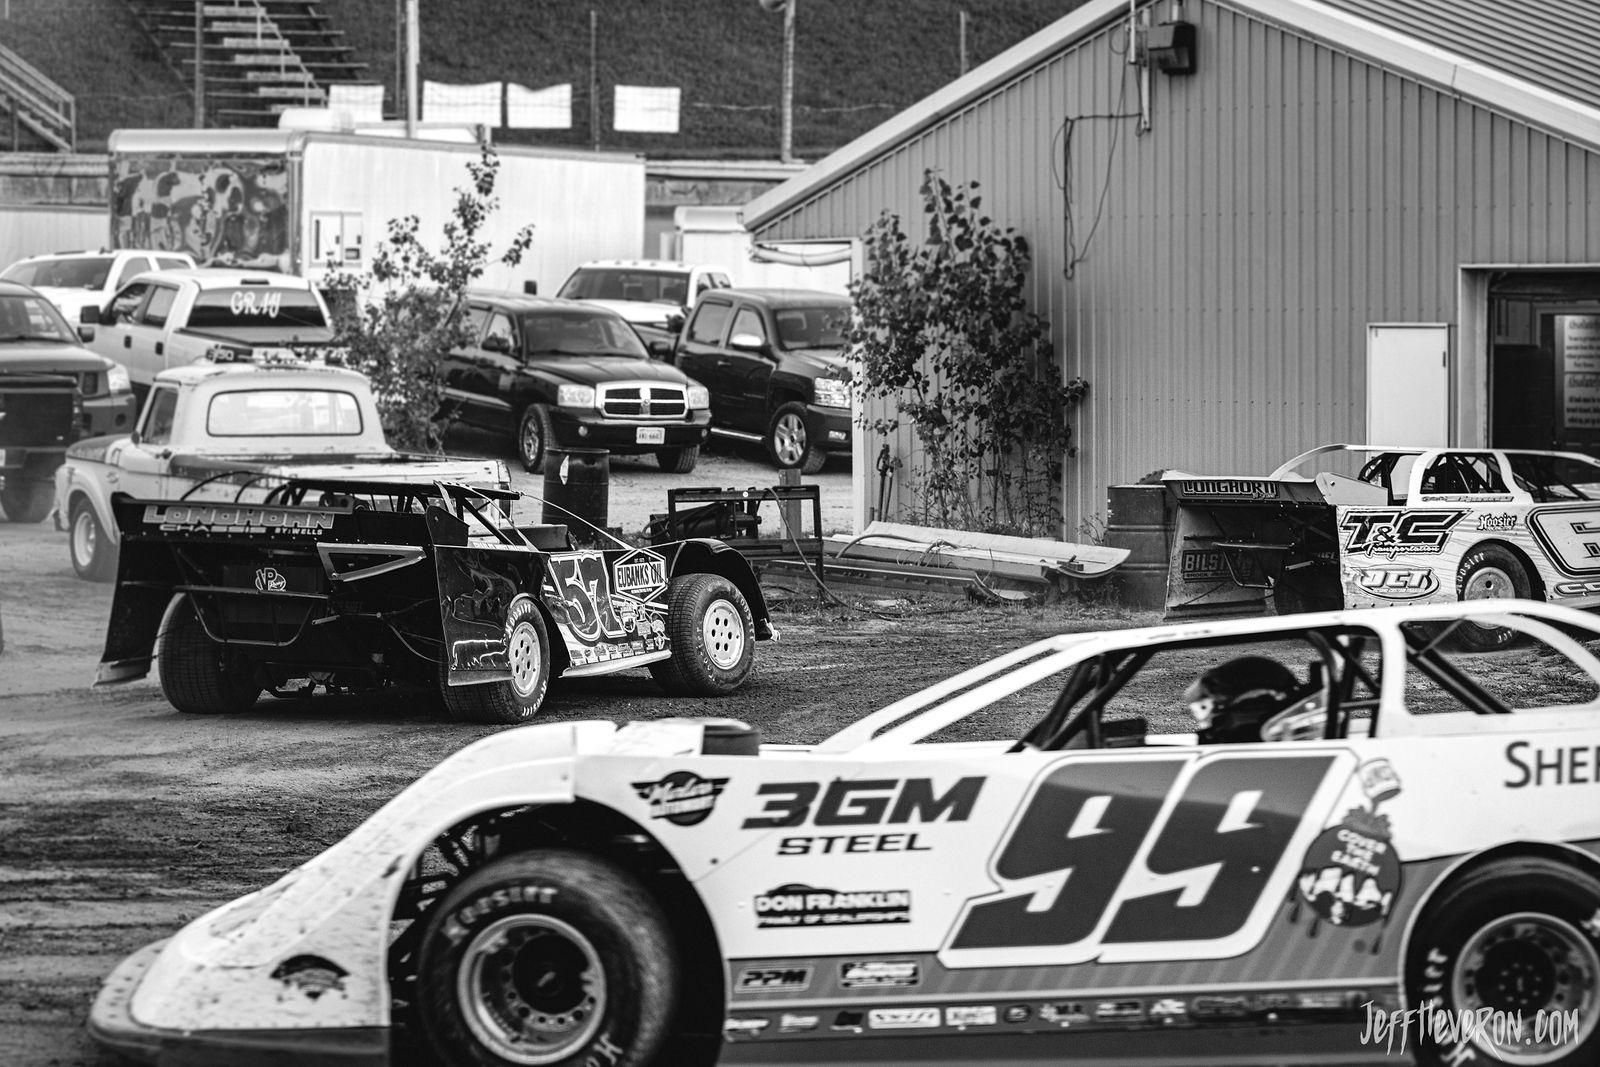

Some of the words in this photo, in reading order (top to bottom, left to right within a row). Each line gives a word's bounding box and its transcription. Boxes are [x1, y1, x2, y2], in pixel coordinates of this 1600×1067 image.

[1182, 480, 1277, 495] LONGHORN
[143, 504, 334, 529] LONGHORN
[159, 523, 267, 533] CHASSIS
[1477, 513, 1518, 530] Hoosier
[1340, 509, 1472, 555] T&C
[1362, 540, 1441, 560] Transportation
[255, 568, 277, 590] VP
[618, 565, 650, 588] EUBANKS
[650, 562, 664, 585] OIL
[548, 552, 627, 641] 57
[740, 776, 987, 830] 3GM
[777, 833, 932, 856] STEEL
[1337, 829, 1387, 855] COVER
[1346, 842, 1375, 862] THE
[944, 752, 1348, 957] 99
[1330, 850, 1381, 876] EARTH
[755, 894, 804, 912] DON
[805, 890, 909, 911] FRANKLIN
[743, 969, 808, 987] PPM
